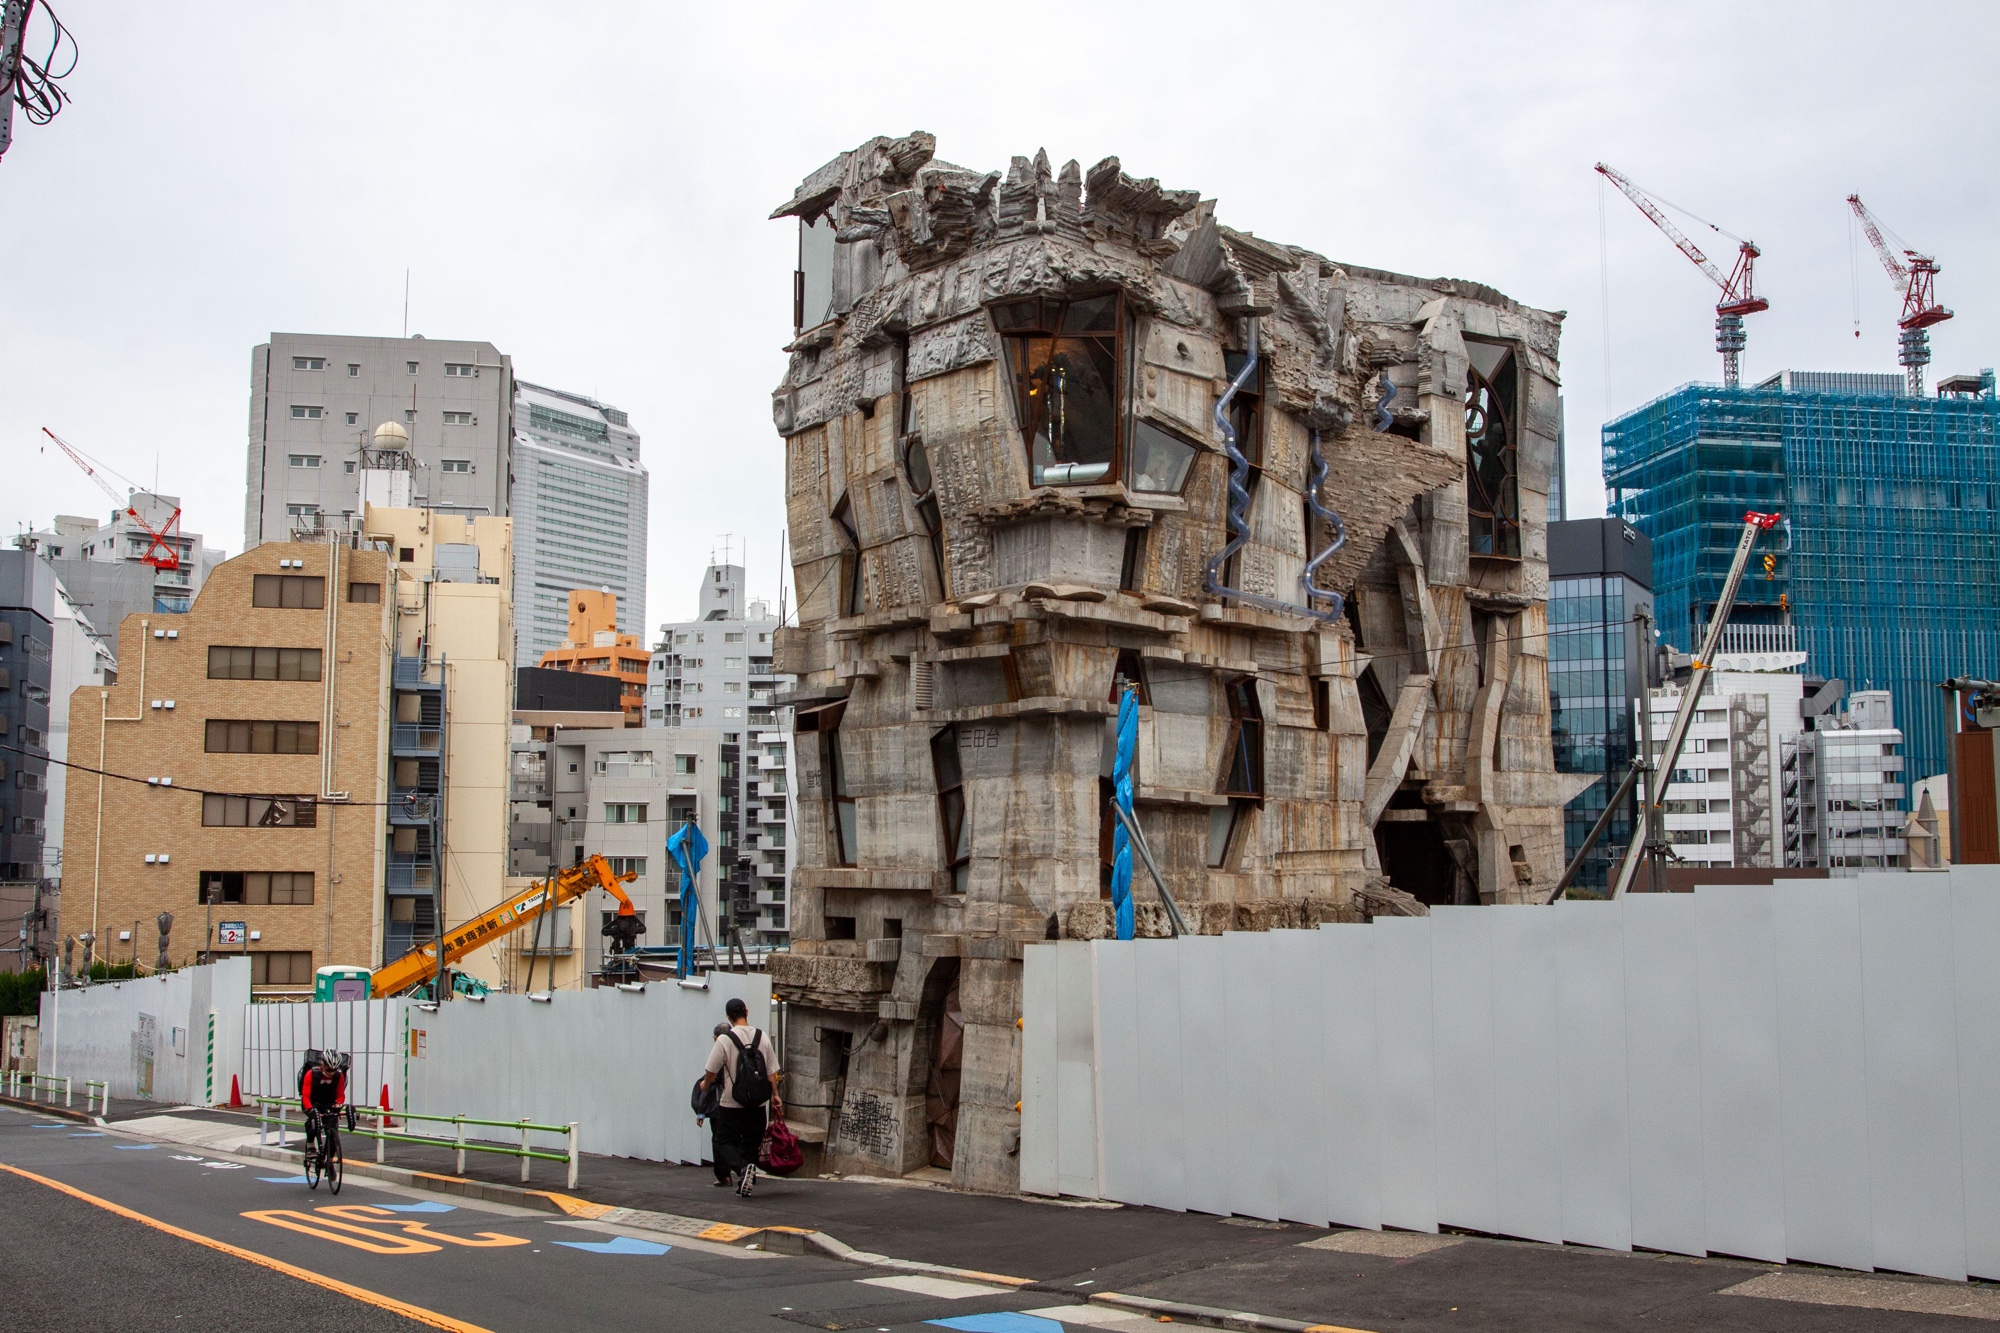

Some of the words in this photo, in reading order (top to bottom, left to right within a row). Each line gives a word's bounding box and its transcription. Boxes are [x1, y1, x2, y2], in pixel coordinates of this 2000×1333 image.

[1741, 529, 1753, 550] KATO
[960, 727, 1000, 748] 三田台
[528, 892, 544, 903] TADAN
